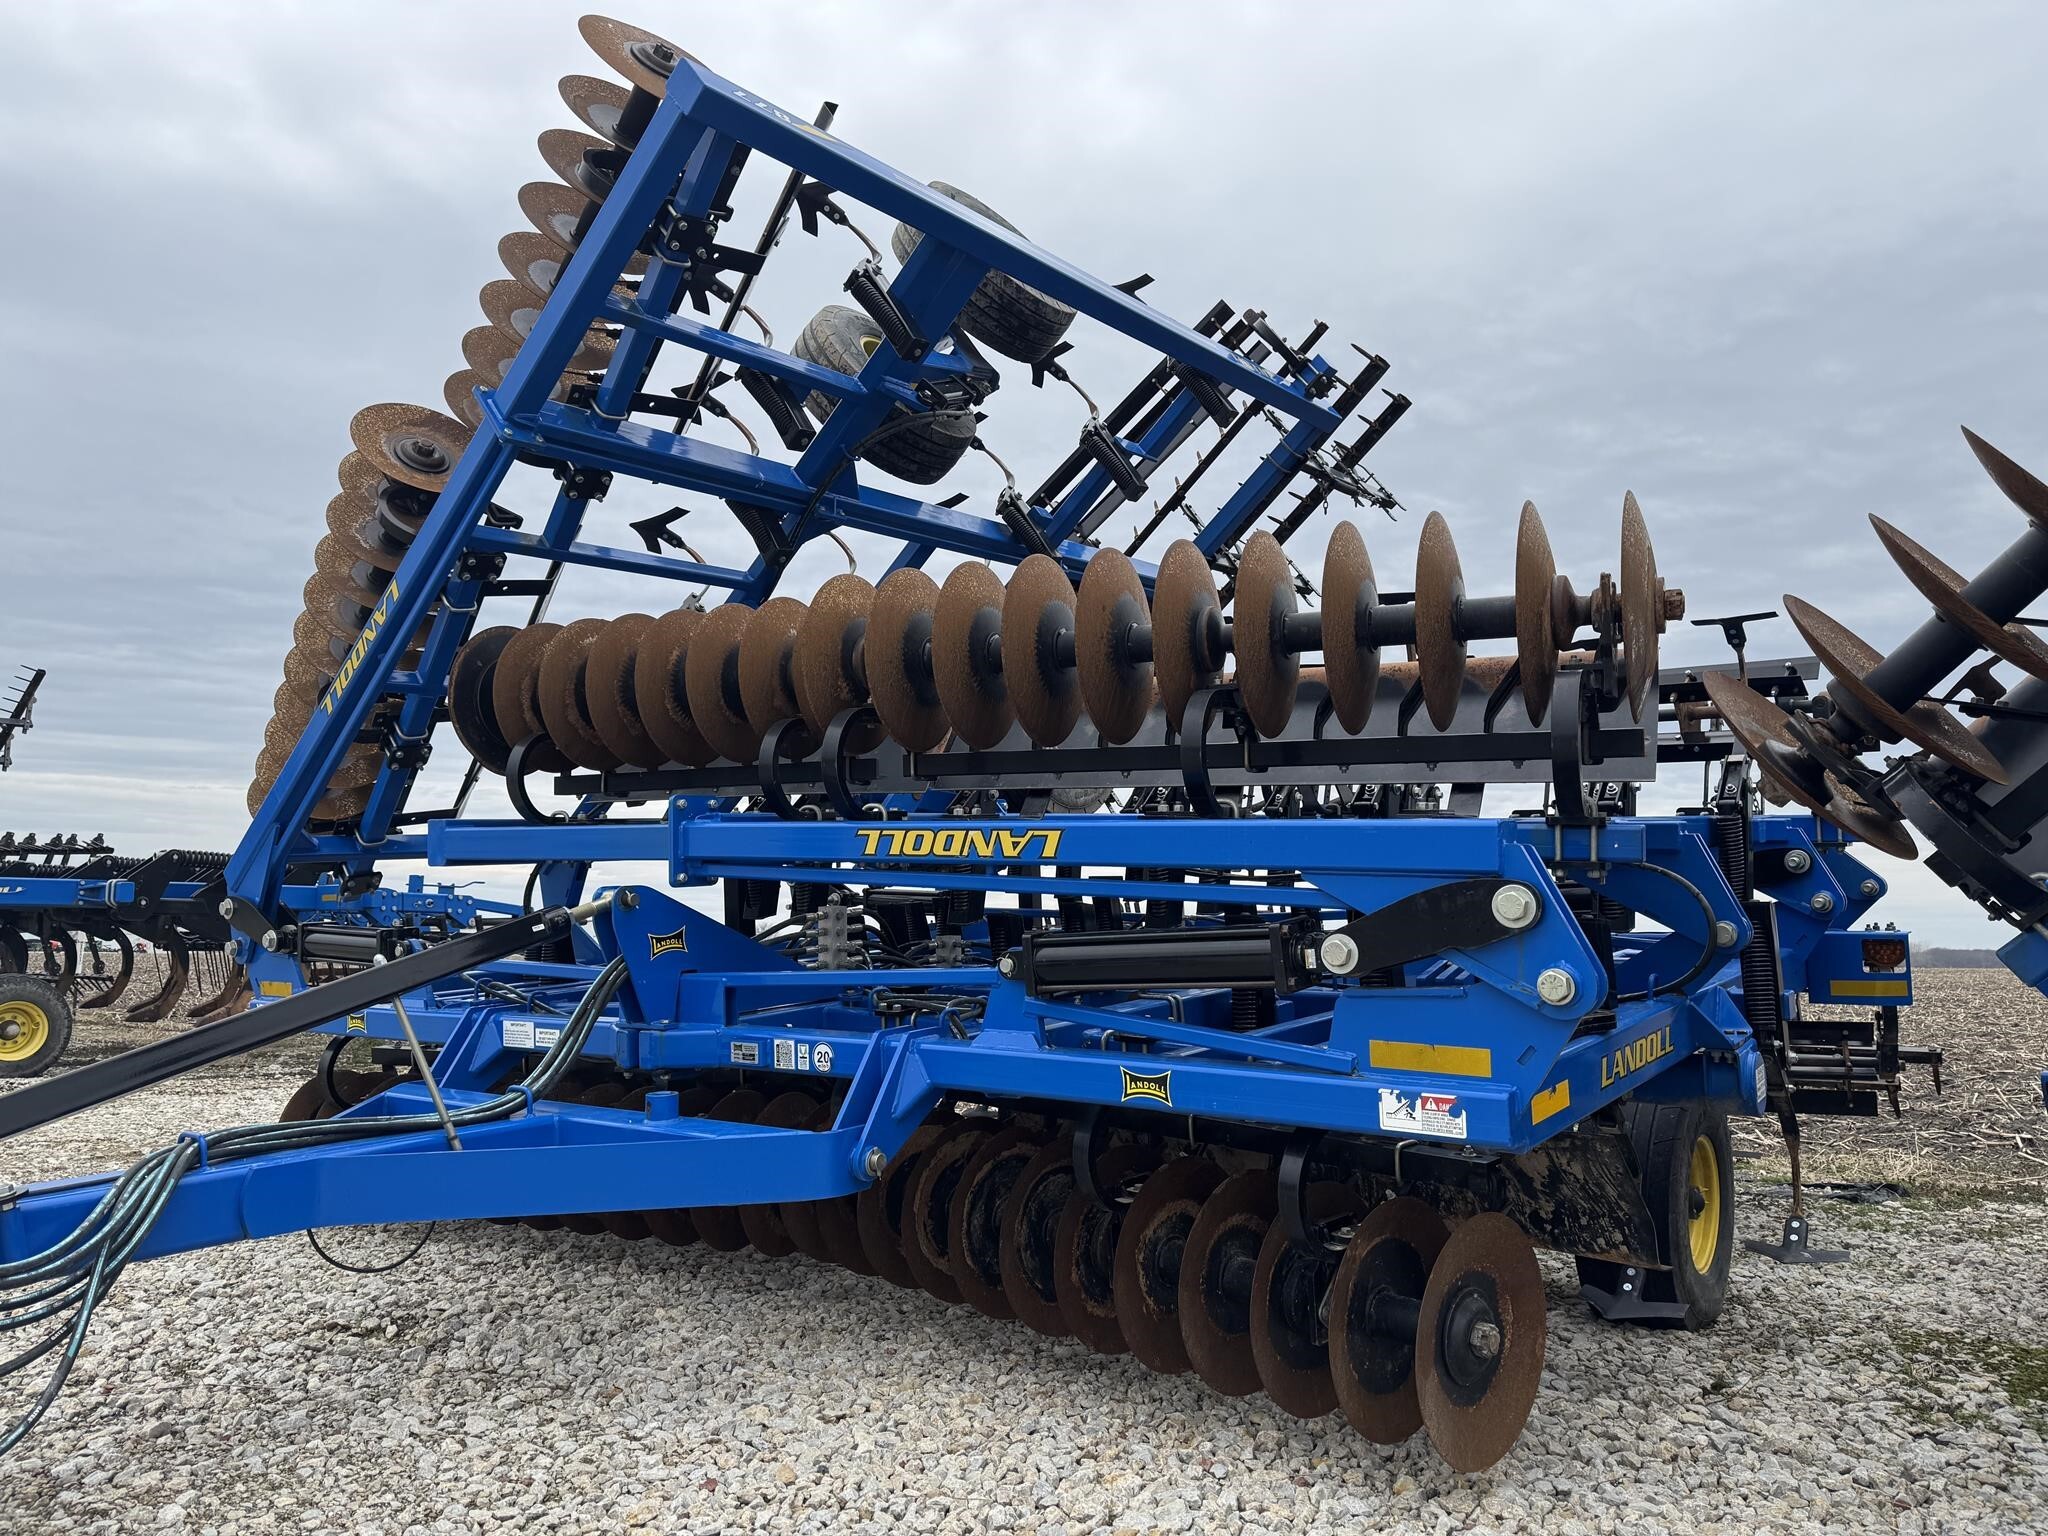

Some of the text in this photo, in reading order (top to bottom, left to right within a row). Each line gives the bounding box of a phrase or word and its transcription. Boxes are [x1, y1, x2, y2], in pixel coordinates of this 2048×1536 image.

[320, 579, 400, 716] LANDOLL
[856, 829, 1063, 858] LANDOLL
[652, 937, 684, 954] LANDOLL
[816, 1051, 830, 1064] 20
[1601, 1025, 1675, 1090] LANDOLL
[1126, 1073, 1167, 1099] LANDOLL
